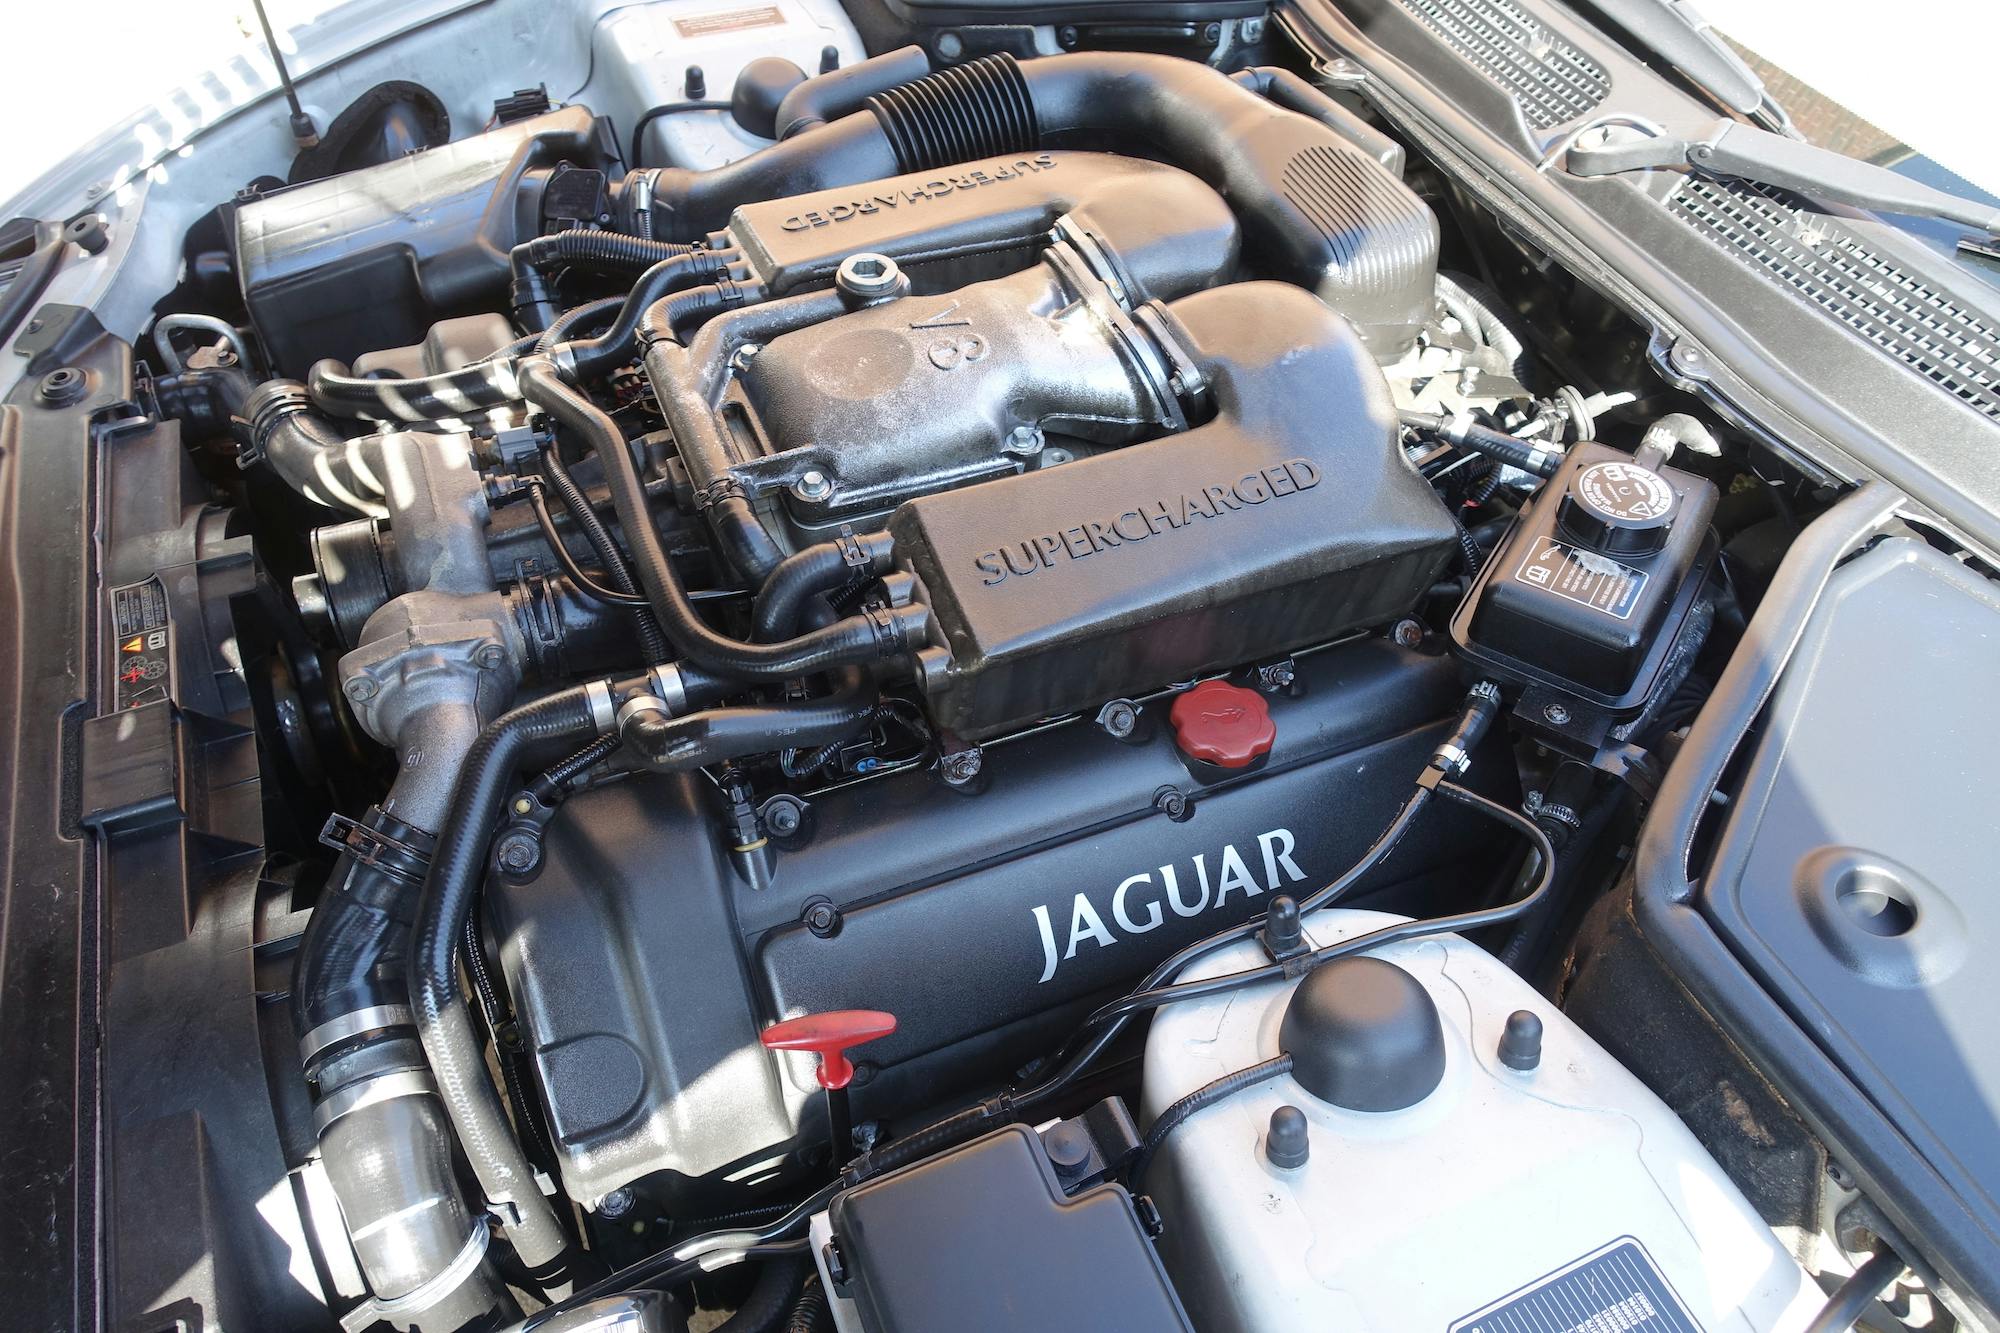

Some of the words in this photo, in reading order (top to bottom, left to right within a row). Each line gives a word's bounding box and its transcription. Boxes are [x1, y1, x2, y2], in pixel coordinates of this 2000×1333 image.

[780, 153, 1057, 232] SUPERCHARGED
[909, 301, 989, 371] V8
[974, 457, 1322, 586] SUPERCHARGED
[1031, 828, 1308, 984] JAGUAR
